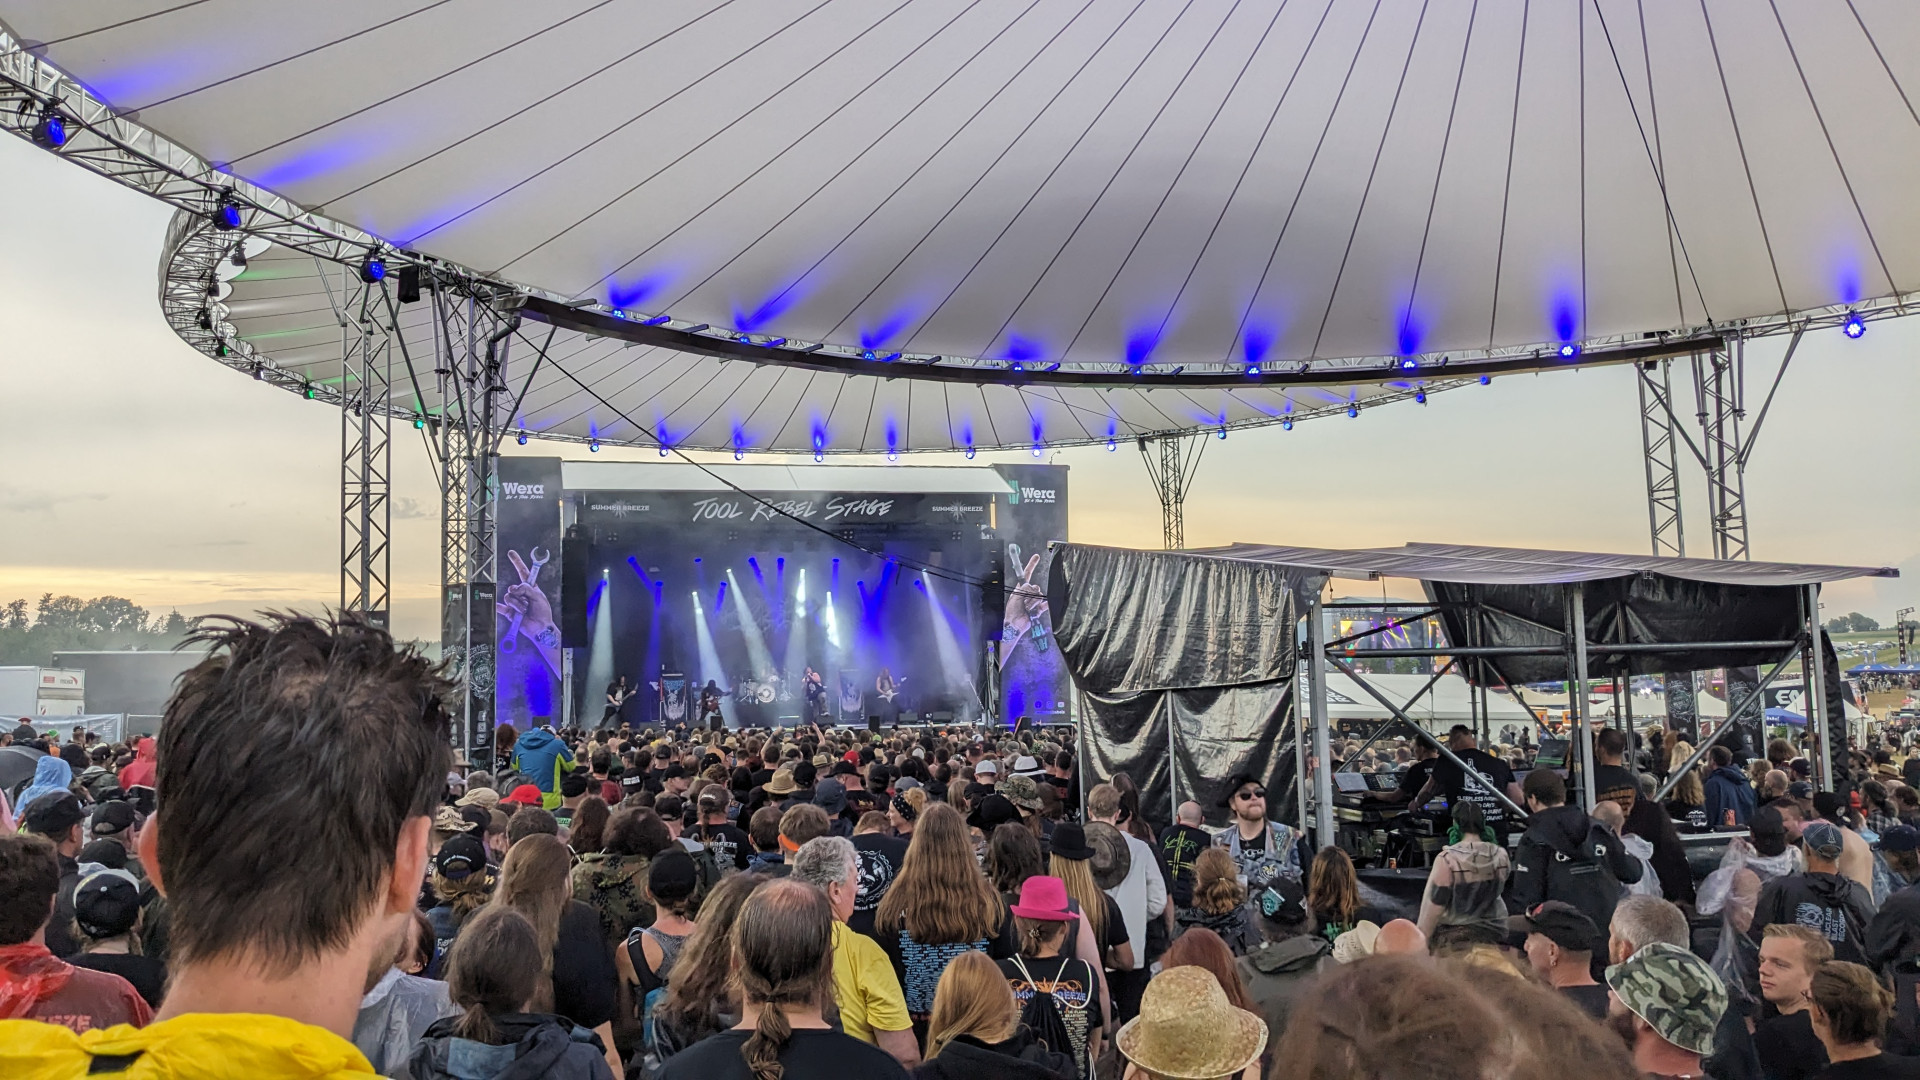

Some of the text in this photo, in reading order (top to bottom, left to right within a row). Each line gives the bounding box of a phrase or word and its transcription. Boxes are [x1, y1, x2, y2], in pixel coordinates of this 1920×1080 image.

[502, 482, 544, 494] Wera
[1021, 487, 1056, 498] Wera
[693, 497, 894, 522] TOOL REBEL STAGE
